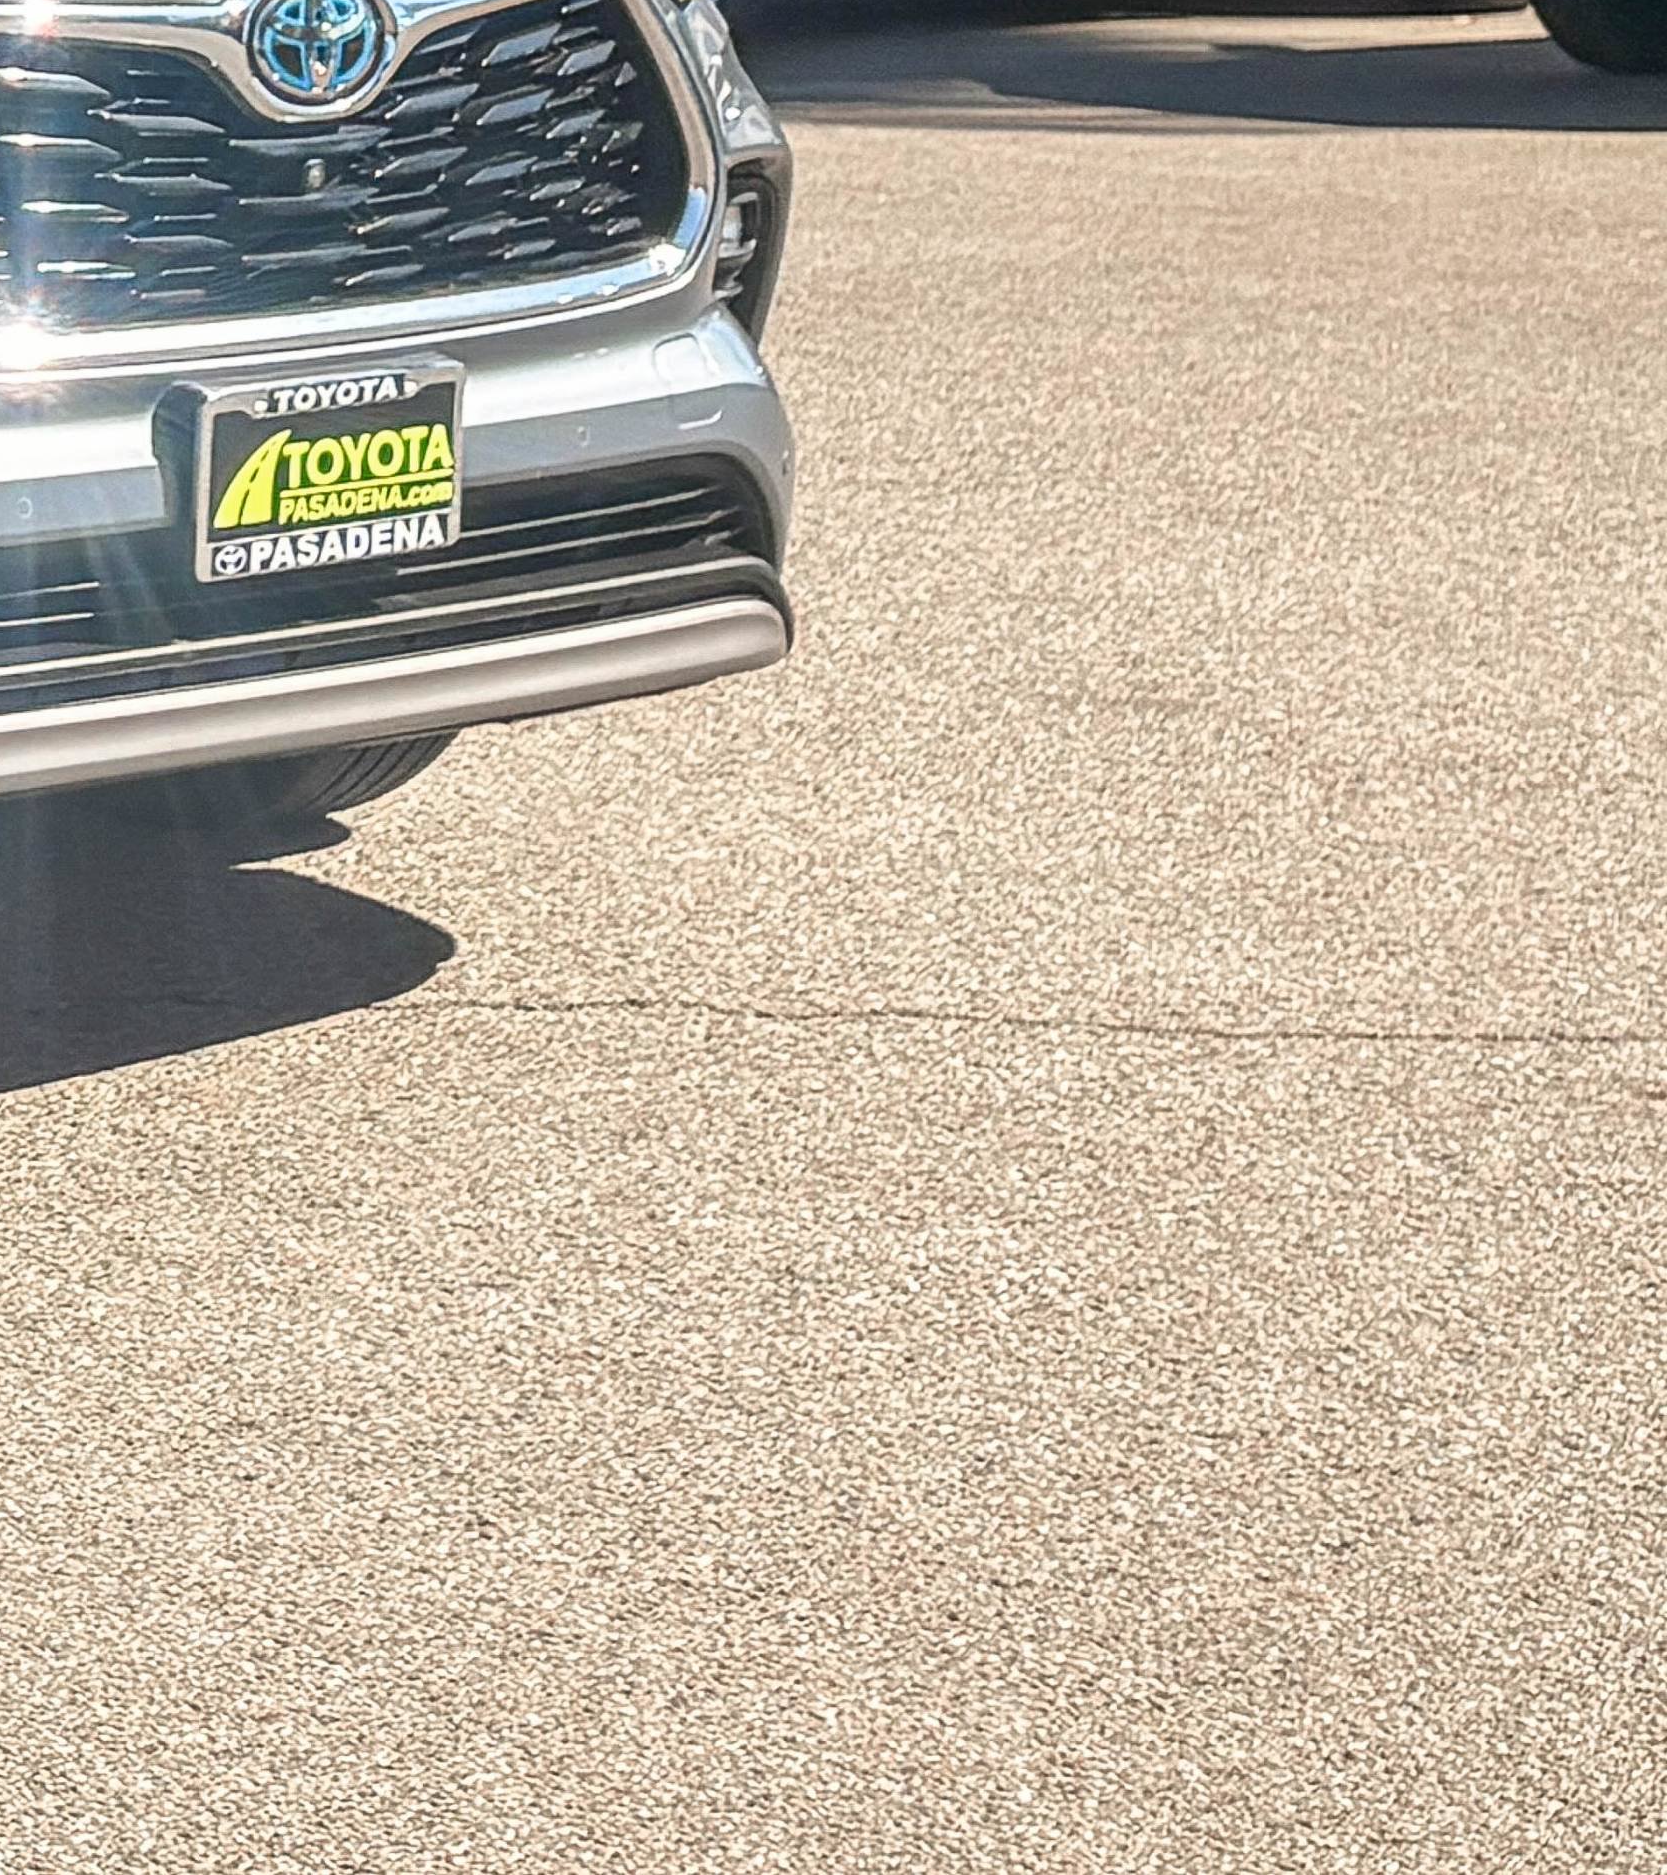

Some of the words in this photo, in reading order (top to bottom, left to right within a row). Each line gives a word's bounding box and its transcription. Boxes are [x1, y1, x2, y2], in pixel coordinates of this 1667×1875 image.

[273, 375, 398, 414] TOYOTA
[281, 423, 455, 489] TOYOTA
[278, 481, 454, 526] PASADENA.com
[249, 513, 445, 574] PASADENA
